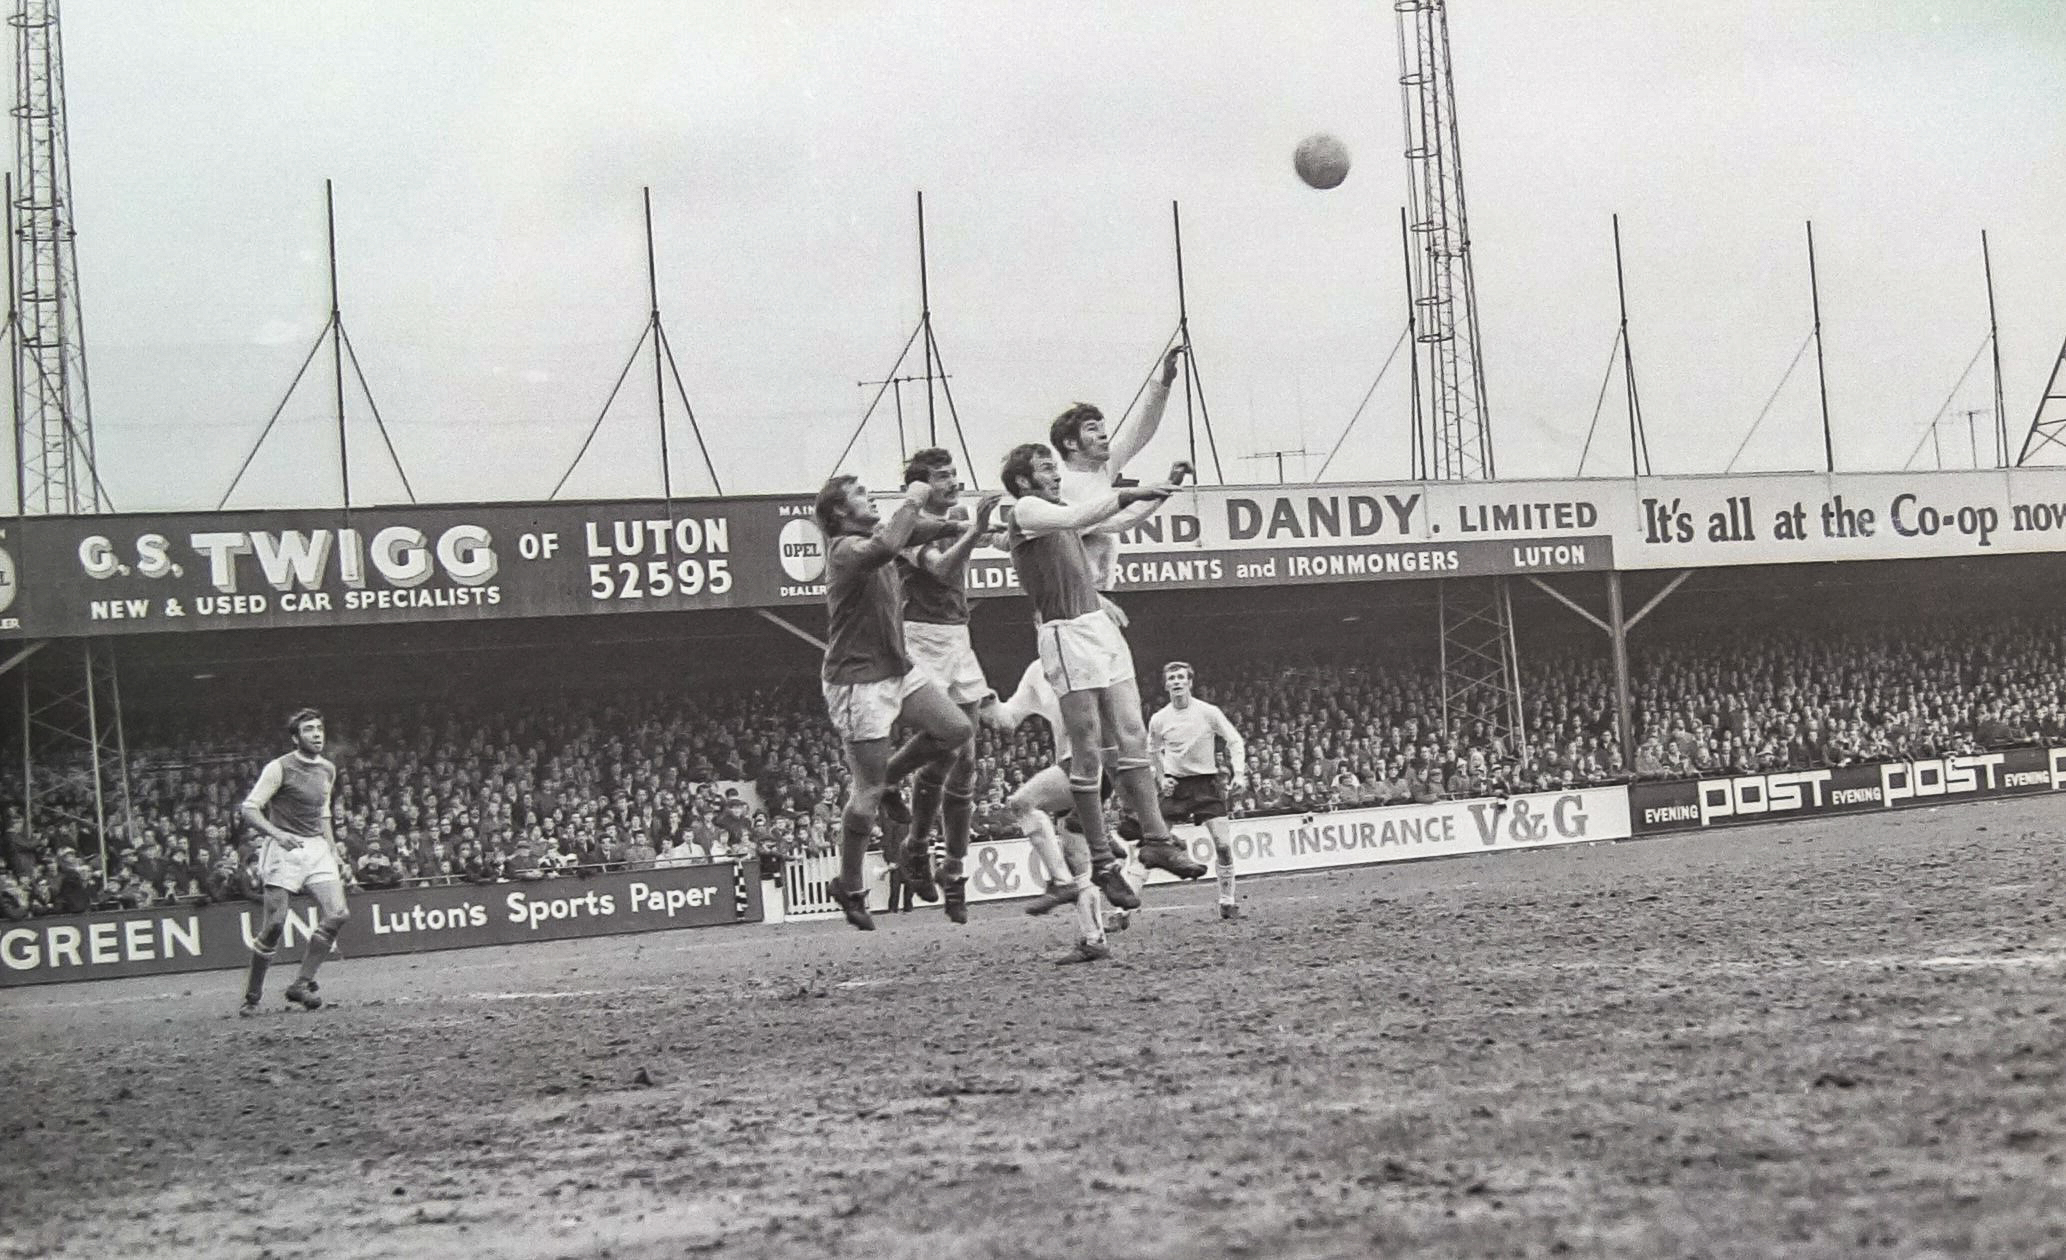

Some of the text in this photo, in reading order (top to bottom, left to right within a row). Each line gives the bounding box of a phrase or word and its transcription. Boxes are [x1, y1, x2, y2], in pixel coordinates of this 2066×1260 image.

[1120, 515, 1200, 544] ND
[1459, 502, 1598, 533] LIMITED
[1642, 496, 1694, 543] It's
[1708, 496, 1755, 541] all
[1773, 501, 1807, 540] at
[1821, 494, 1875, 538] the
[1890, 492, 1998, 546] Co-op
[190, 524, 499, 592] TWIGG
[518, 533, 559, 560] OF
[585, 518, 730, 558] LUTON
[783, 542, 821, 558] OPEL
[1114, 558, 1223, 584] RCHANTS
[1236, 558, 1276, 579] and
[1288, 551, 1459, 577] IRONMONGERS
[1513, 545, 1586, 568] LUTON
[91, 584, 501, 621] NEW & USED CAR SPECIALISTS
[589, 559, 733, 600] 52595
[780, 585, 828, 597] DEALER
[1645, 769, 1833, 826] EVENING POST
[1832, 787, 1883, 806] EVENING
[1881, 753, 2006, 808] POST
[1289, 814, 1457, 856] INSURANCE
[1467, 795, 1590, 846] V&G
[372, 882, 718, 935] Luton's Sports Paper
[0, 916, 202, 971] GREEN
